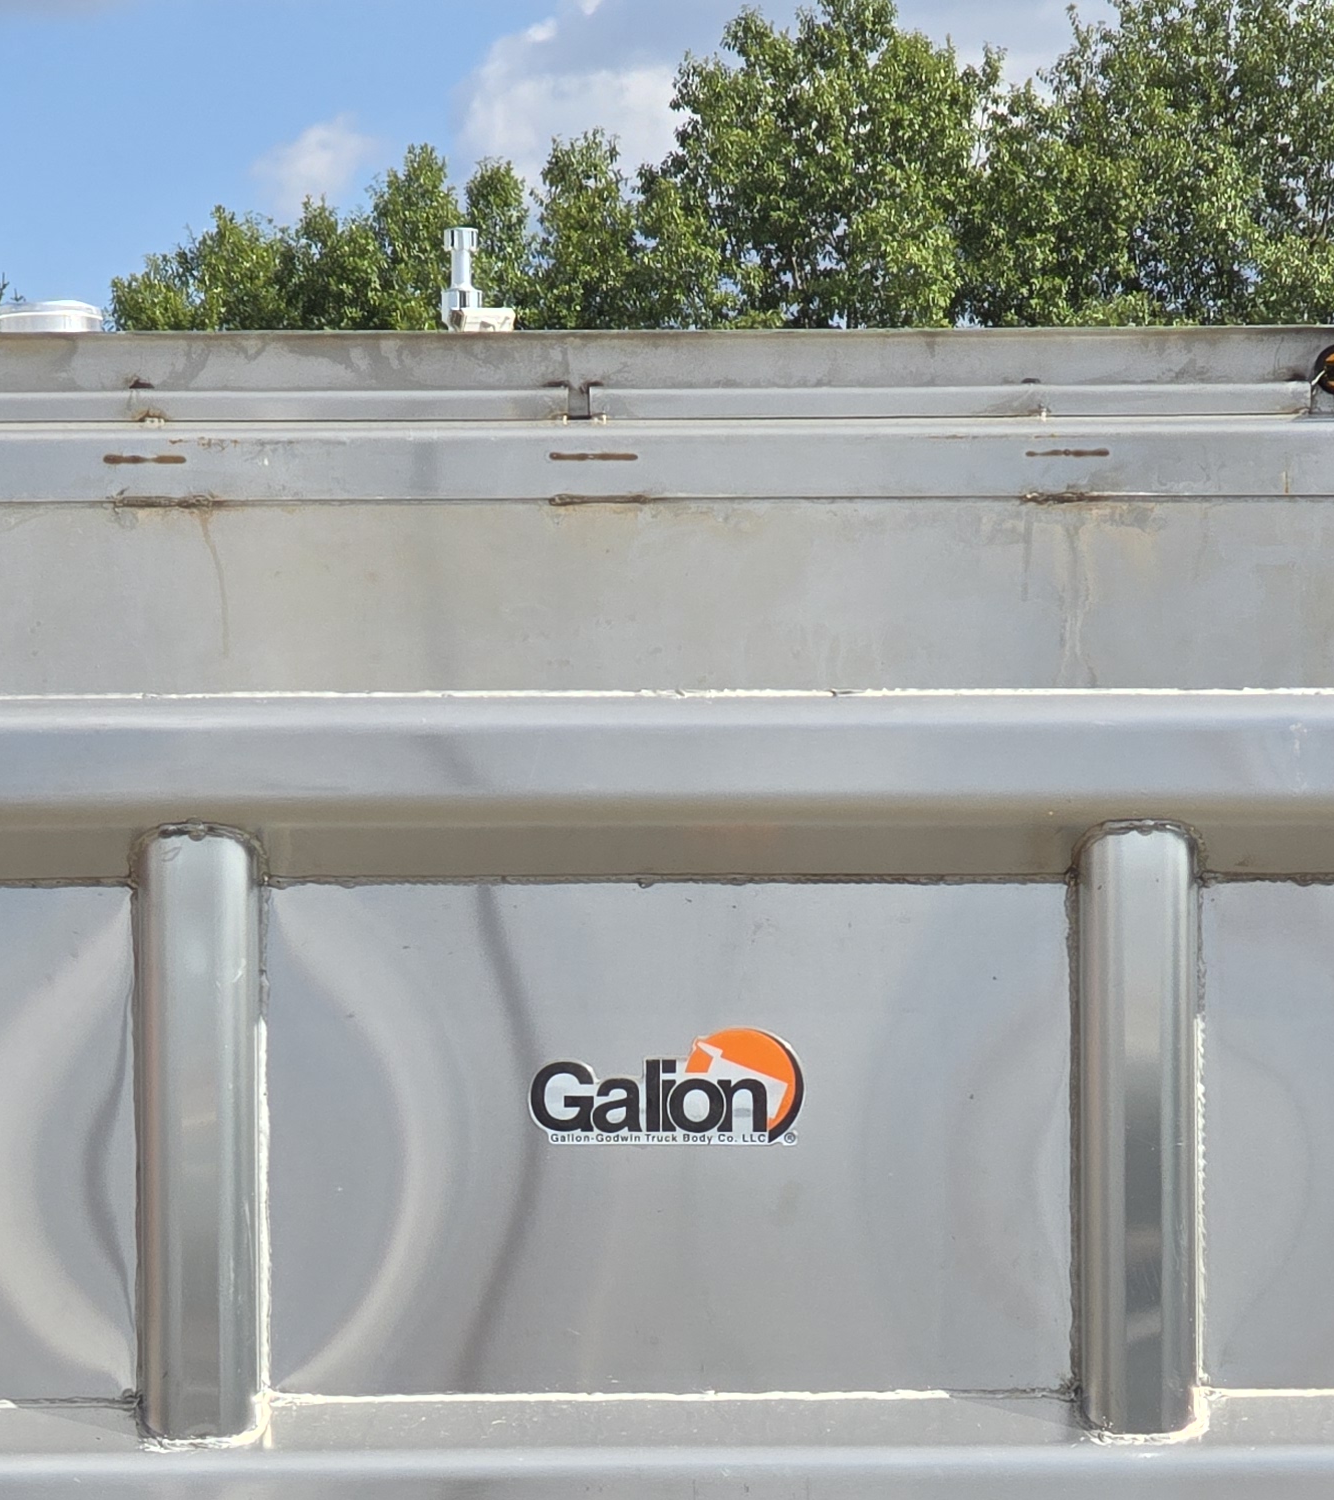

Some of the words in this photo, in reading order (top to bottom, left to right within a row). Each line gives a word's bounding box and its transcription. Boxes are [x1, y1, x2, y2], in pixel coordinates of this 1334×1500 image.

[530, 1058, 768, 1132] Galion
[550, 1133, 641, 1143] Galion-Godwin
[645, 1133, 678, 1143] Truck
[682, 1133, 713, 1145] Body
[717, 1133, 738, 1143] Co.
[742, 1133, 767, 1143] LLC
